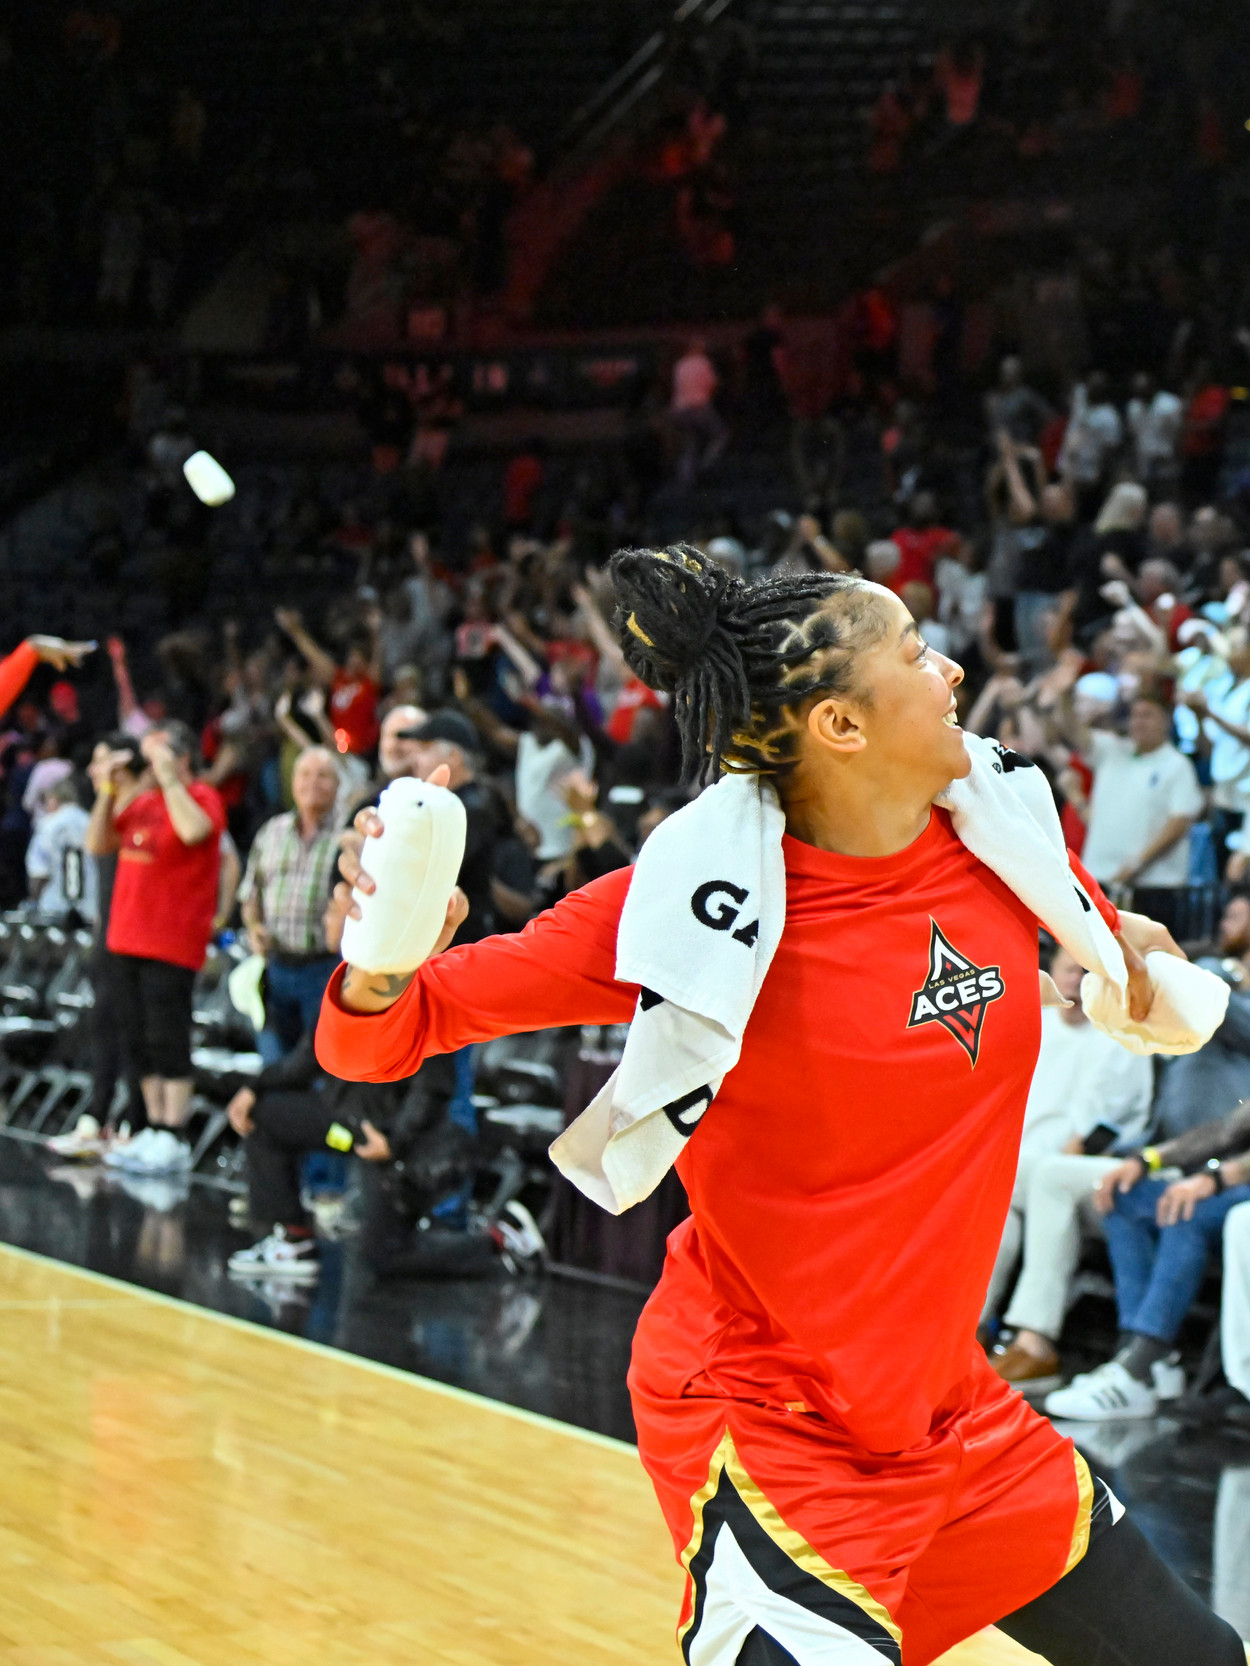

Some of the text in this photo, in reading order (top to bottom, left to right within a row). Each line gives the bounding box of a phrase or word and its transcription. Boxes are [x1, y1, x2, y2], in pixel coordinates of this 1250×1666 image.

[914, 971, 1001, 1020] ACES
[928, 969, 976, 989] LAS VEGAS
